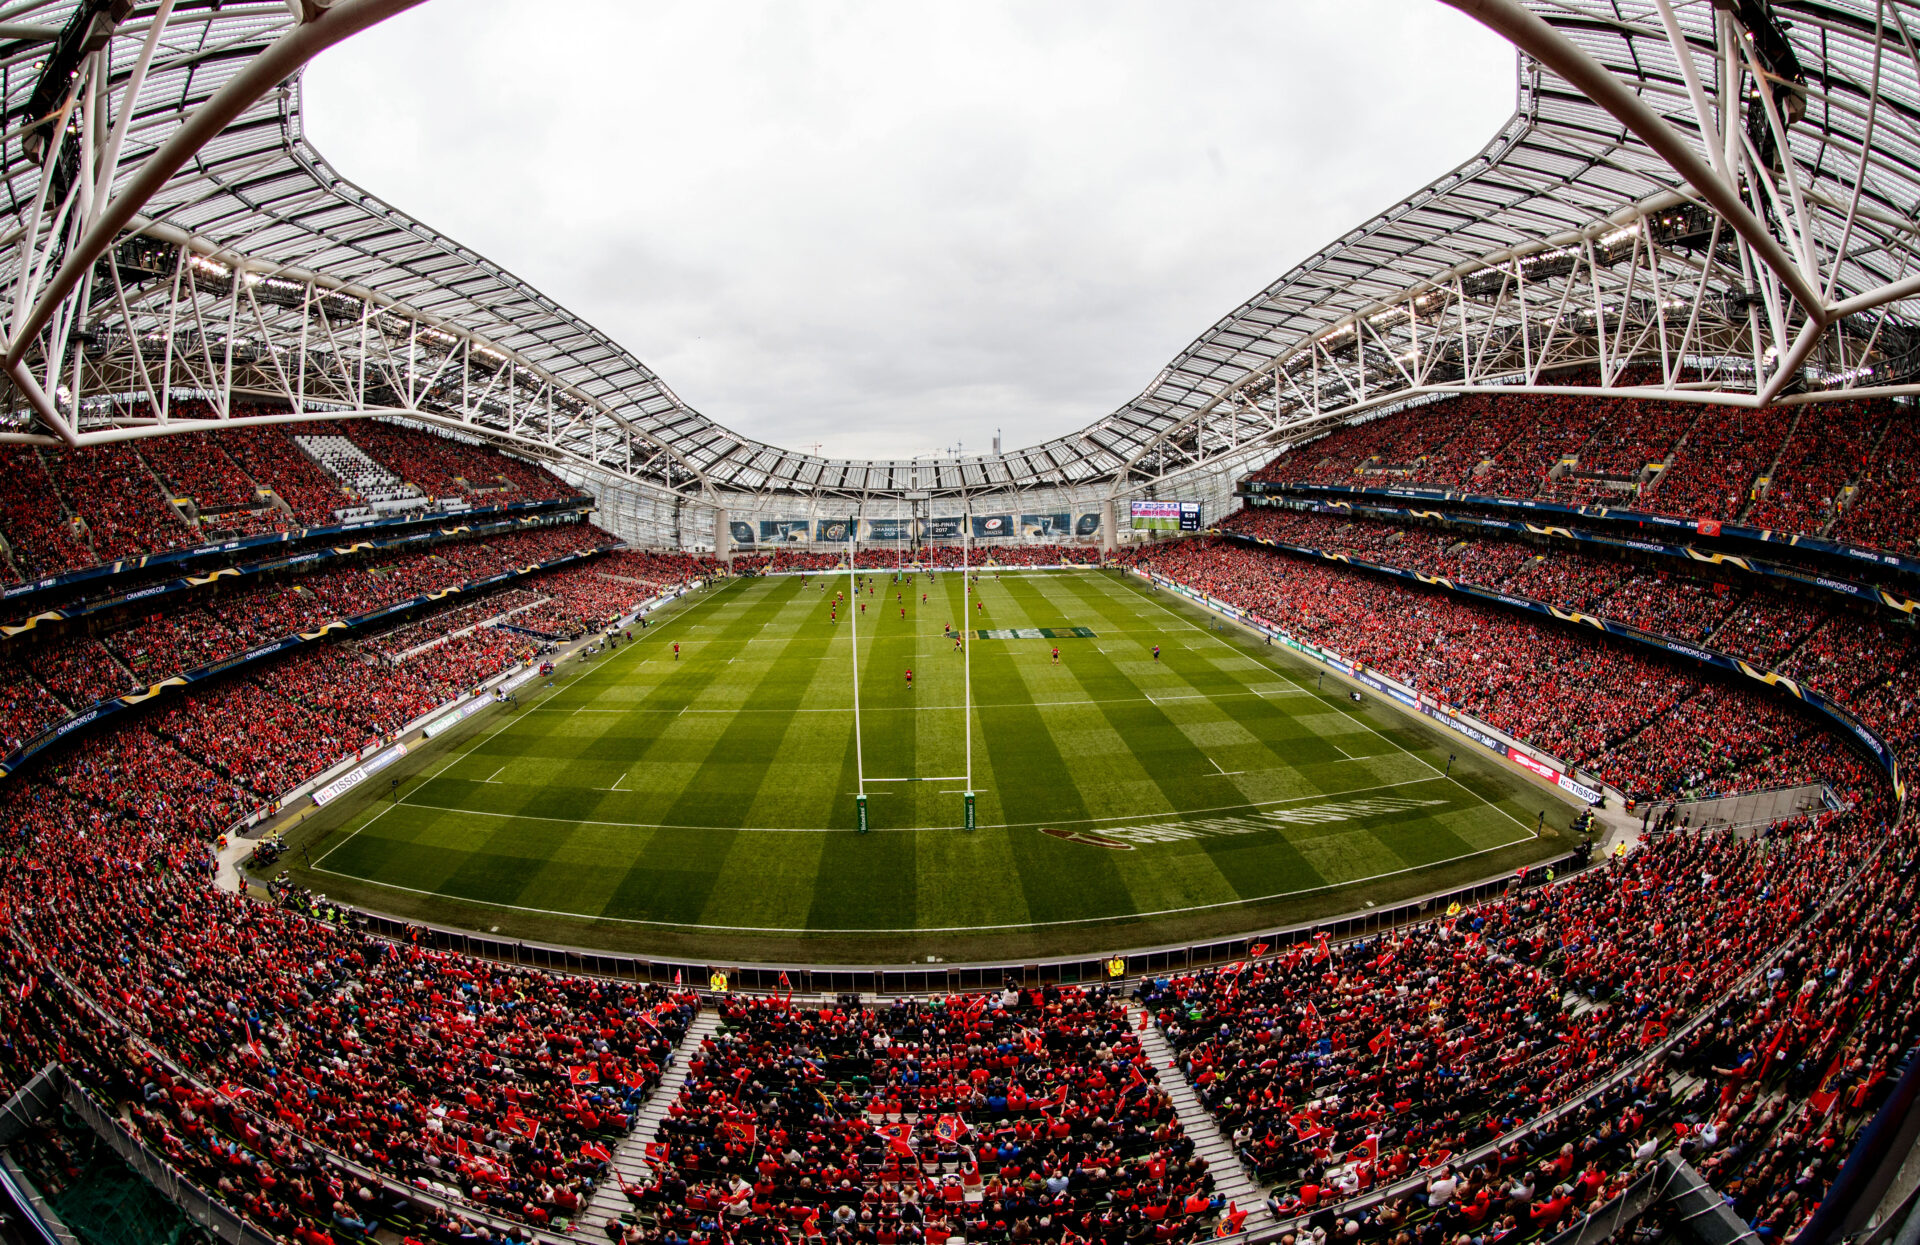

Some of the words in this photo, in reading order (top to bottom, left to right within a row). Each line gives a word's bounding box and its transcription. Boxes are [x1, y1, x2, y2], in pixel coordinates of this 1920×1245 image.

[1626, 541, 1654, 550] CHAMPIONS
[126, 587, 155, 600] CHAMPIONS
[155, 585, 166, 594] CUP
[1816, 577, 1847, 591] CHAMPIONS
[1847, 584, 1858, 594] CUP
[245, 647, 272, 660] CHAMPIONS
[1667, 642, 1699, 657] CHAMPIONS
[1699, 652, 1712, 660] CUP
[57, 716, 87, 735] CHAMPIONS
[87, 710, 98, 721] CUP
[1432, 711, 1450, 725] FINALS
[1450, 719, 1481, 741] EDINBURGH
[329, 768, 364, 795] TISSOT
[1571, 782, 1600, 802] TISSOT
